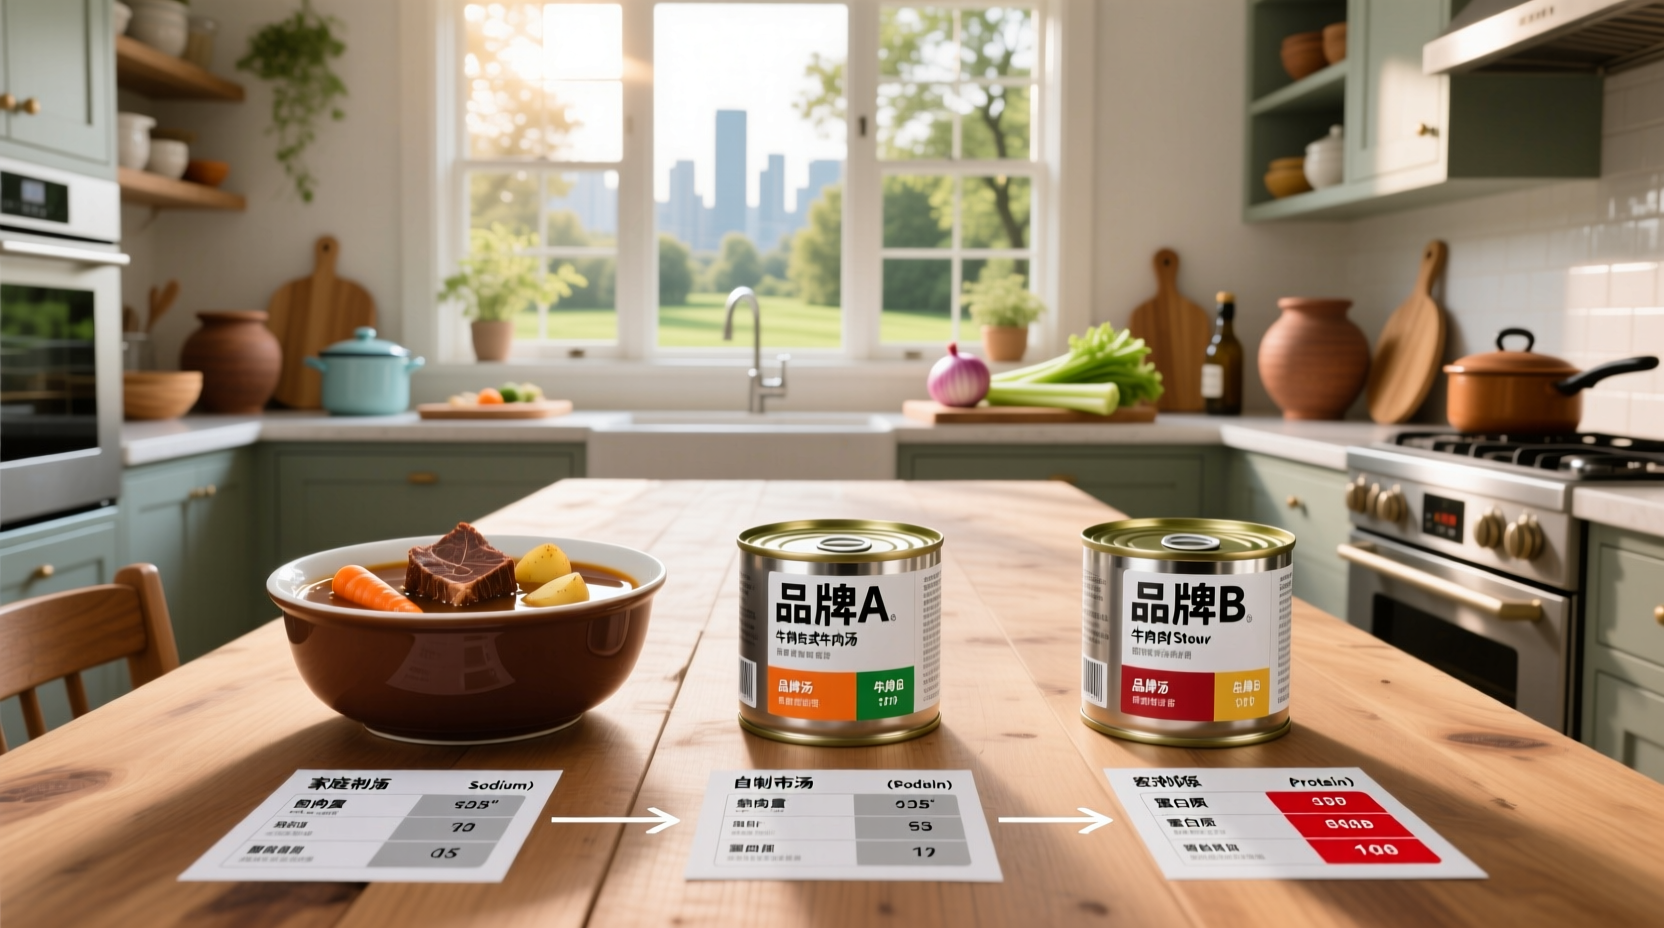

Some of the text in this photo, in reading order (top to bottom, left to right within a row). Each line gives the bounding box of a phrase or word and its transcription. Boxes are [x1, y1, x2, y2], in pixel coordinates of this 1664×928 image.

[776, 582, 889, 626] 品牌A
[1131, 581, 1246, 625] 品牌B
[468, 780, 534, 791] Sodium)
